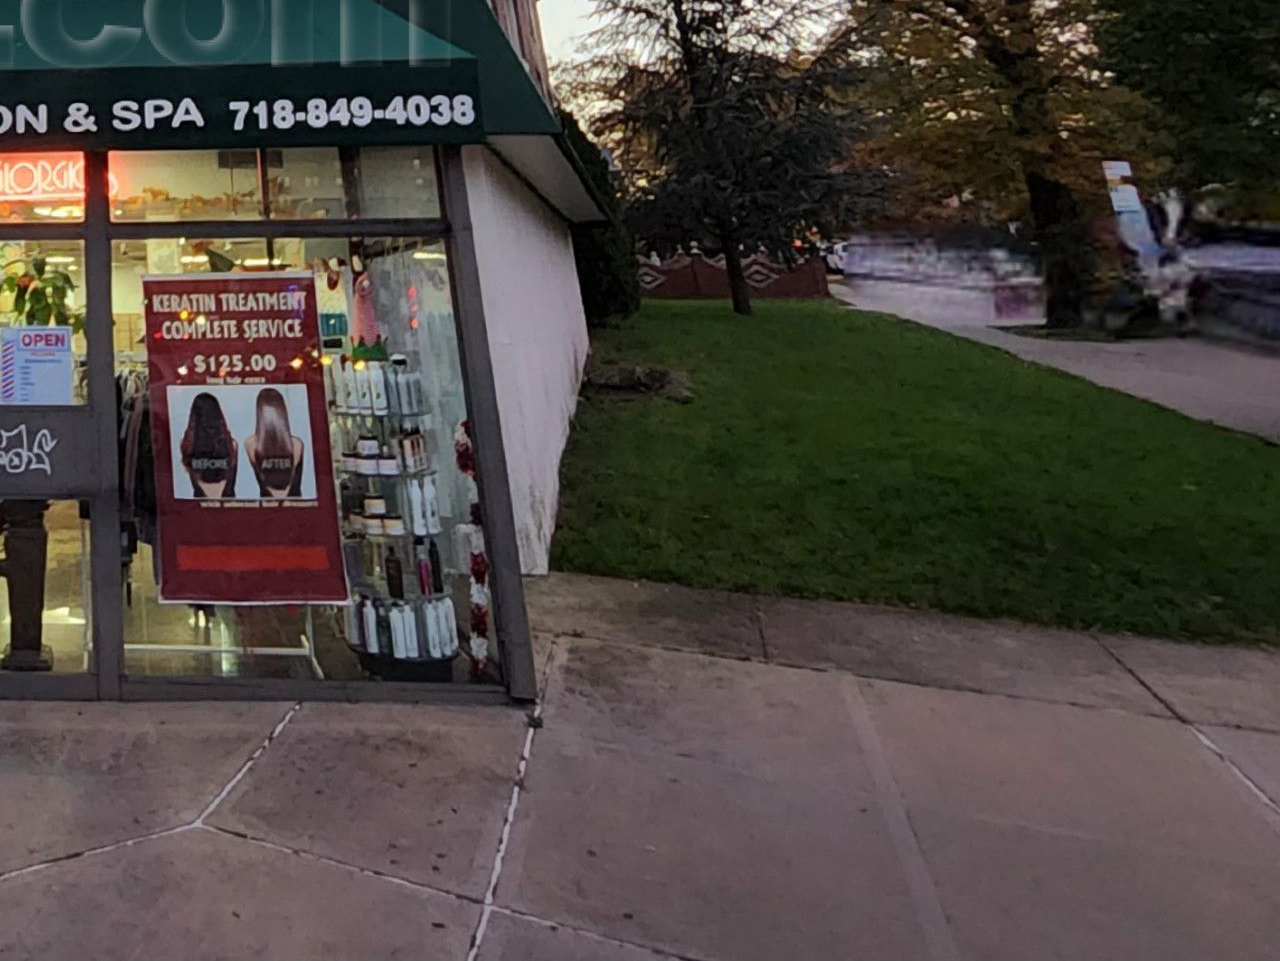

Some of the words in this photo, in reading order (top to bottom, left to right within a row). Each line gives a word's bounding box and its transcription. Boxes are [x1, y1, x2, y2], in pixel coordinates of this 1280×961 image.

[63, 102, 98, 133] &
[112, 97, 205, 130] SPA
[228, 94, 475, 131] 718-849-4038
[153, 292, 215, 313] KERATIN
[220, 291, 306, 313] TREATMENT
[161, 320, 239, 339] COMPLETE
[243, 319, 304, 339] SERVICE
[22, 333, 65, 347] OPEN
[193, 354, 277, 374] $125.00
[191, 458, 229, 470] BEFORE
[261, 458, 292, 470] AFTER
